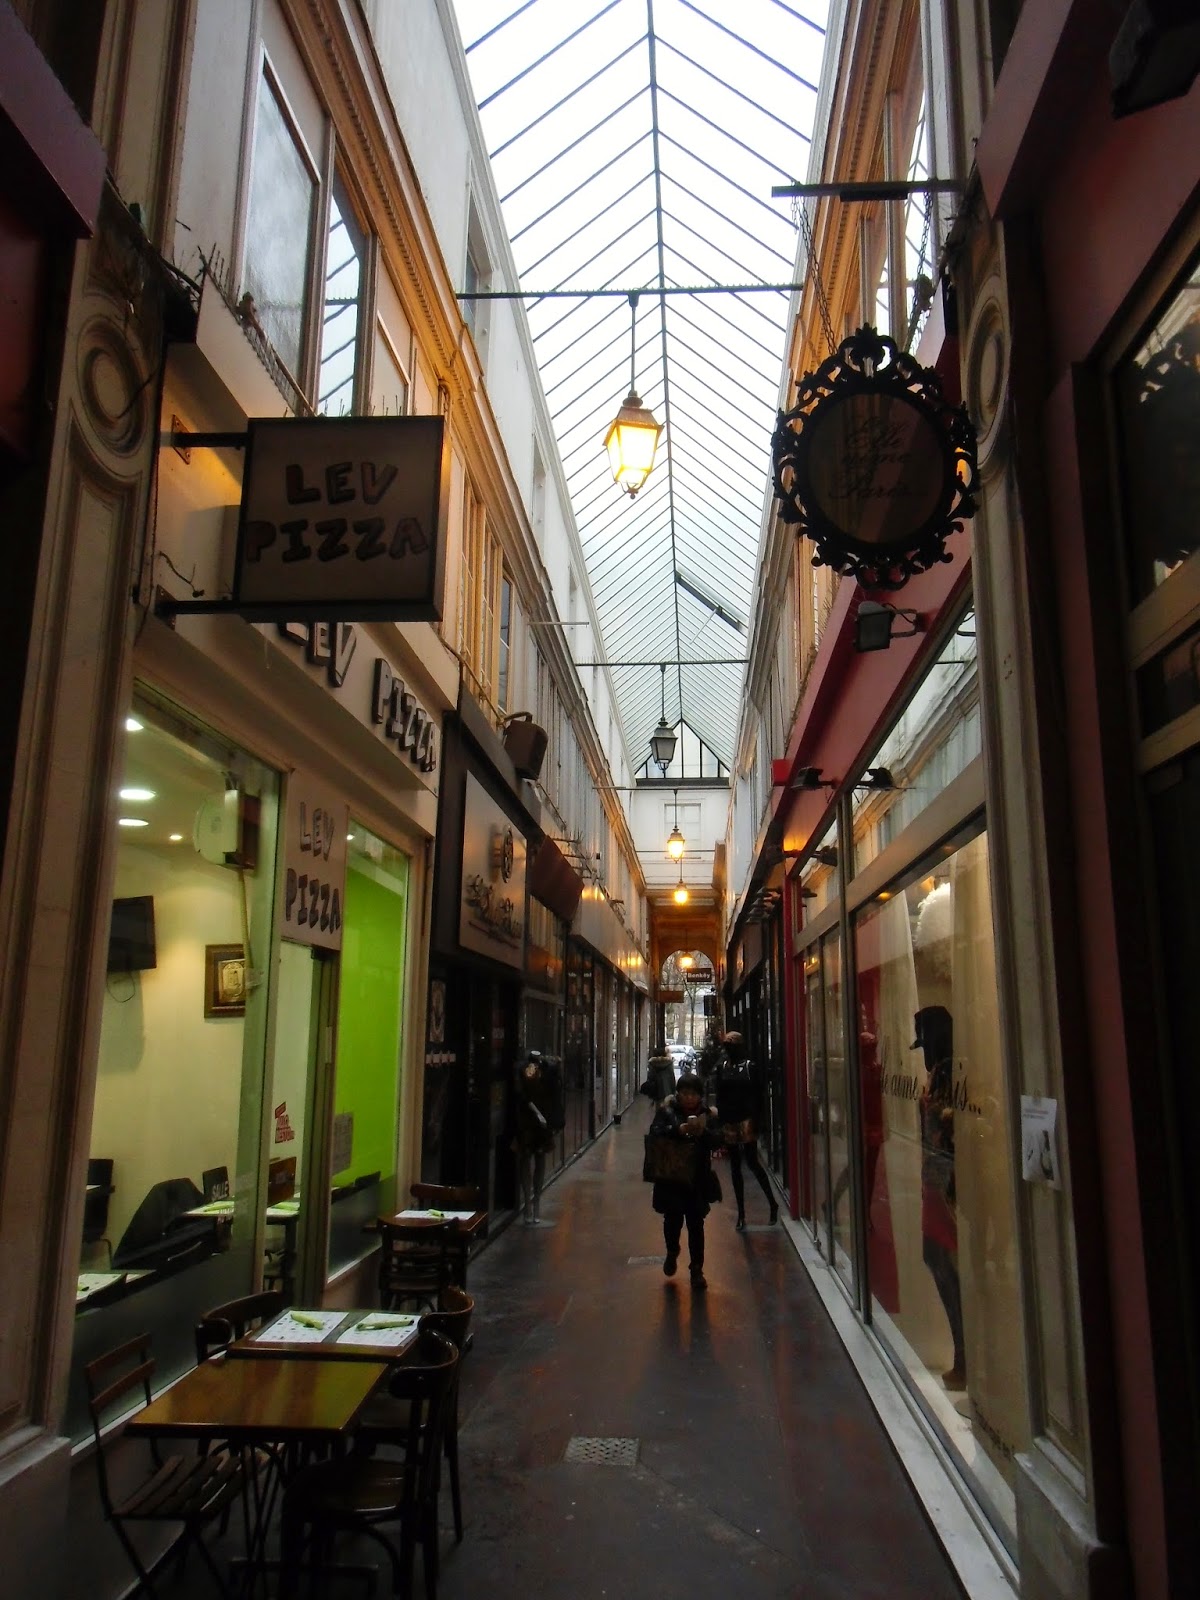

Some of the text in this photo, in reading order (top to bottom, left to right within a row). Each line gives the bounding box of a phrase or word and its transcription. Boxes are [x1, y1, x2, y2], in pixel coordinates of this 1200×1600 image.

[286, 461, 399, 505] LEV
[245, 517, 430, 563] PIZZA
[371, 657, 436, 773] PIZZA
[299, 801, 336, 862] LEV
[285, 867, 341, 934] PIZZA
